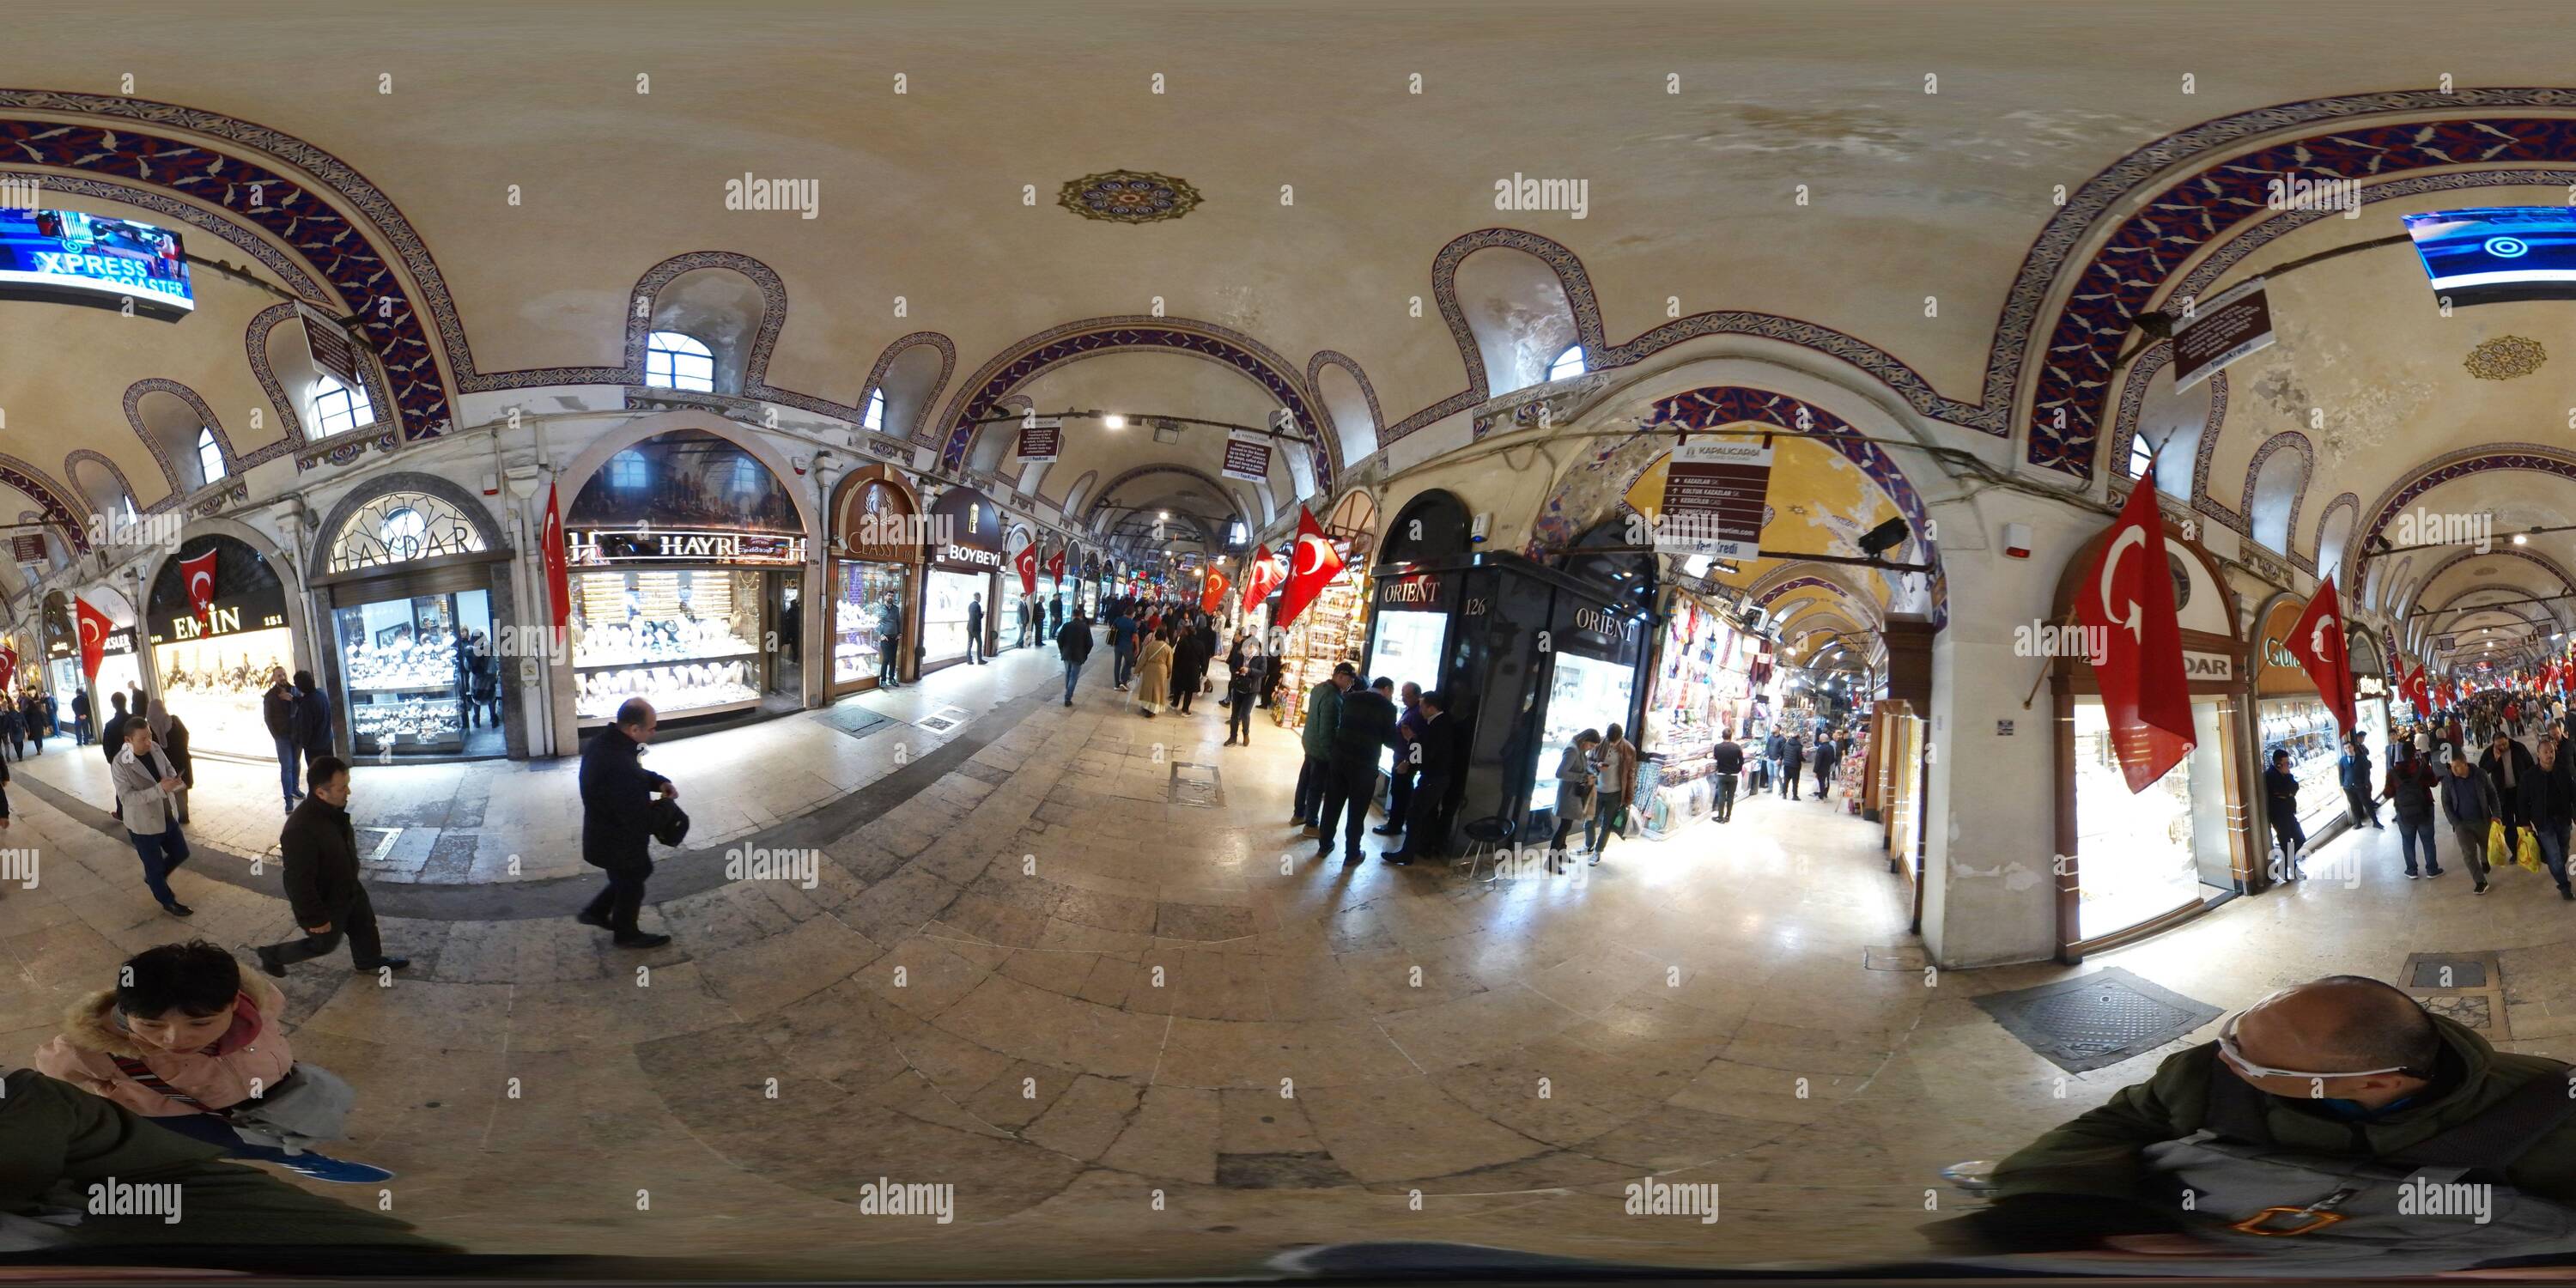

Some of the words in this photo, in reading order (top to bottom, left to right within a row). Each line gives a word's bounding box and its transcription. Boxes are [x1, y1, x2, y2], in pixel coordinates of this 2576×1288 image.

[35, 251, 148, 278] XPRESS
[330, 526, 471, 574] HAYDAR
[660, 534, 740, 556] HAYRİ
[949, 544, 1001, 567] BOYBEYİ
[1465, 598, 1485, 616] 126
[173, 603, 240, 640] EMİN
[264, 615, 283, 626] 151
[2184, 657, 2227, 675] DAR
